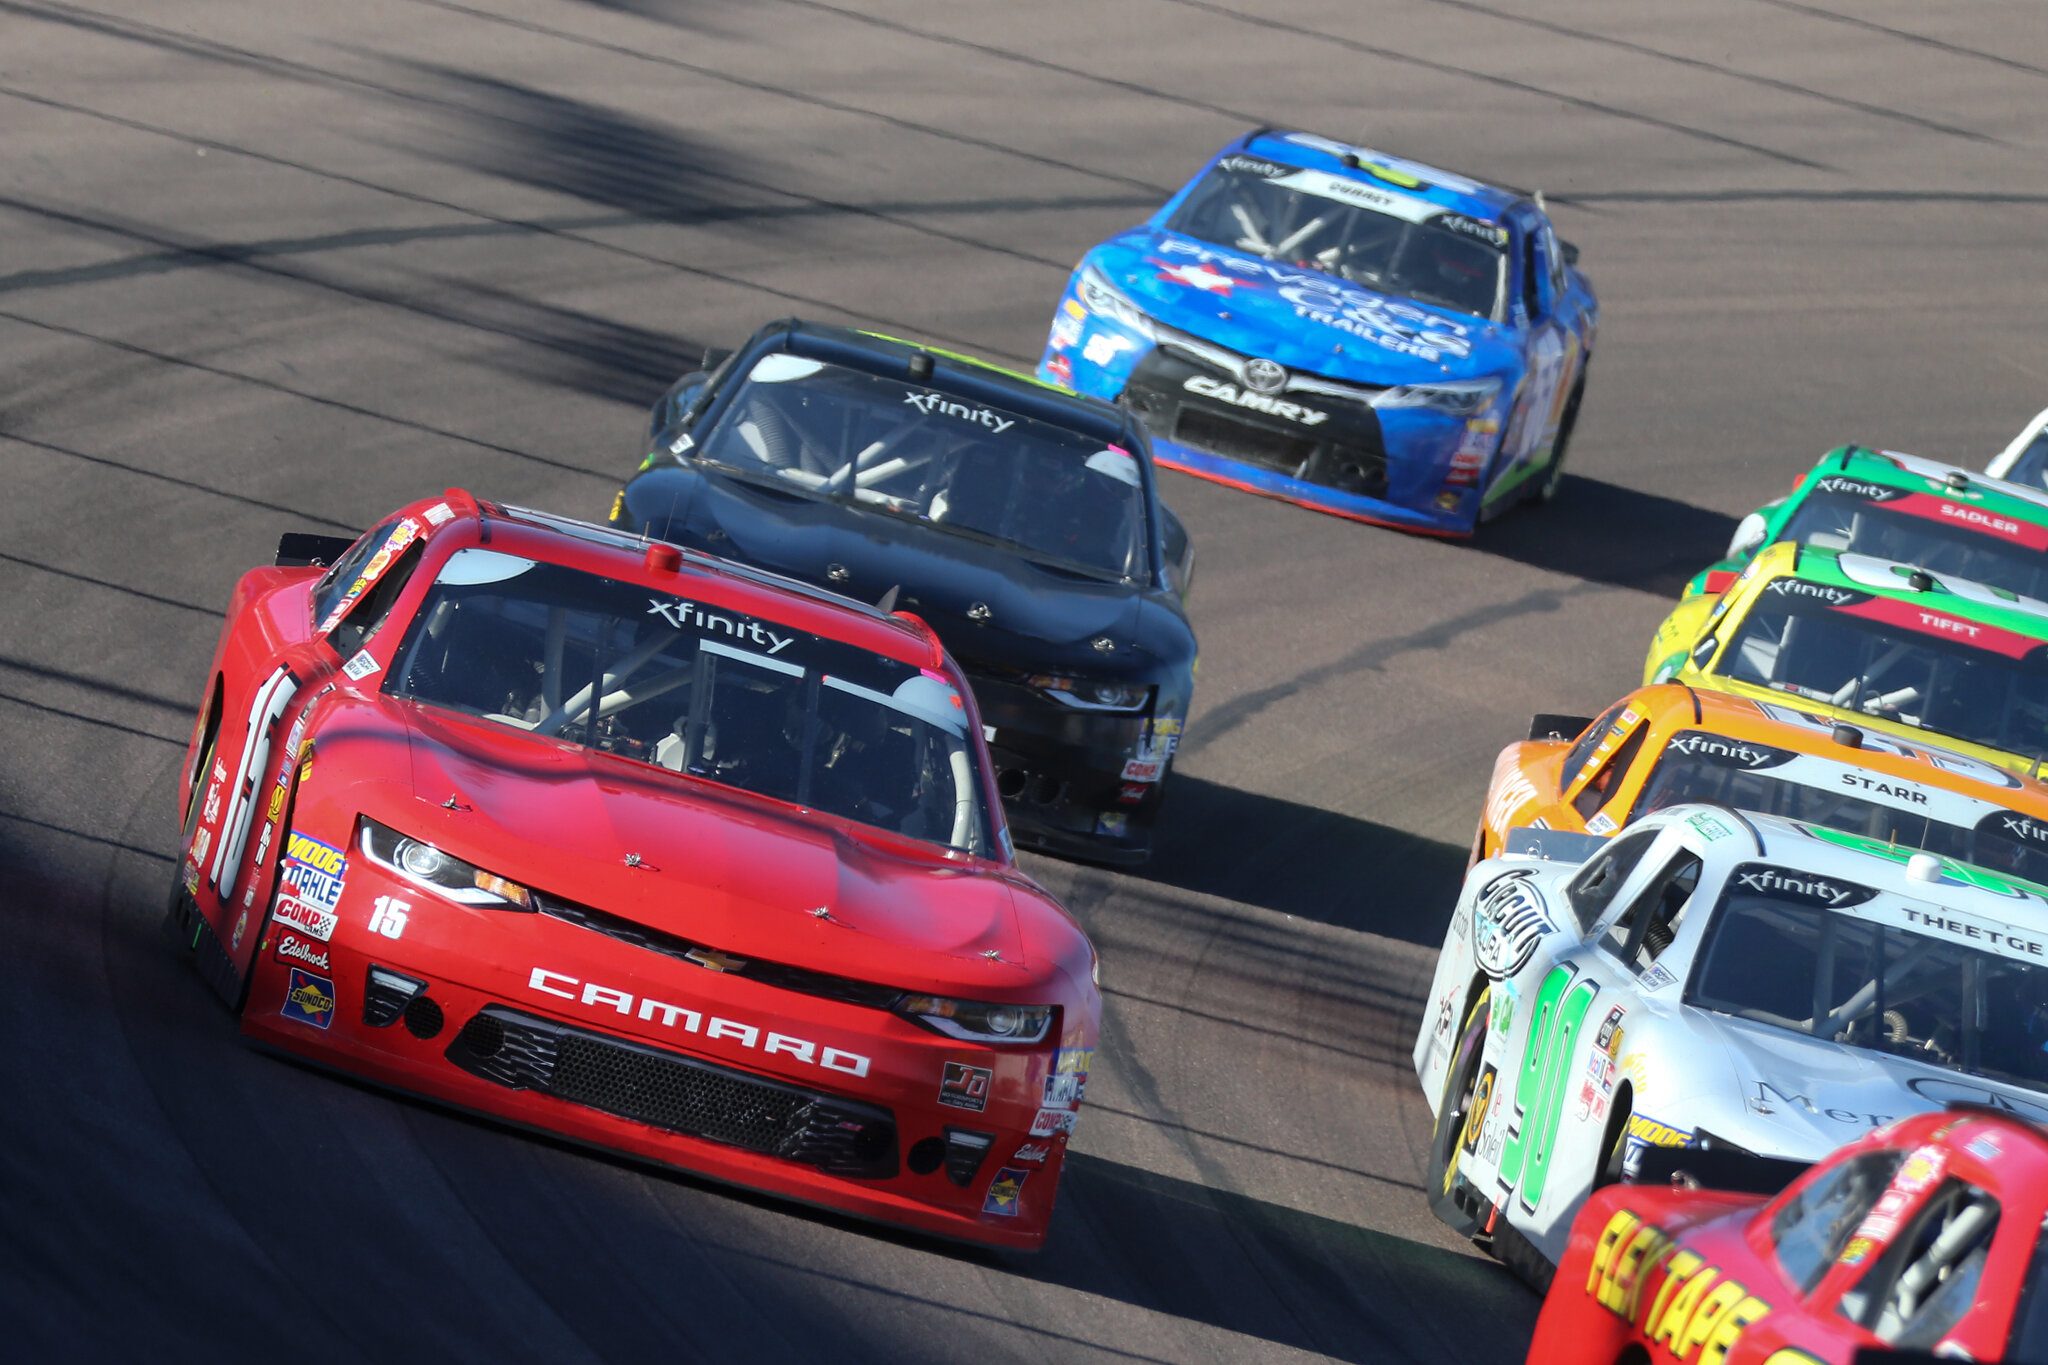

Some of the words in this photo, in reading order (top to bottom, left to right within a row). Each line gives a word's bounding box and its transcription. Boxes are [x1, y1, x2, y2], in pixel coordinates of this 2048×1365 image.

[903, 390, 1016, 434] xfinity
[1182, 375, 1329, 425] CAMRY
[1816, 477, 1897, 502] xfinity
[1940, 503, 2019, 536] SADLER
[1766, 579, 1853, 606] xfinity
[647, 598, 795, 655] xfinity
[1919, 612, 1981, 638] TIFFT
[1665, 735, 1772, 770] xfinity
[1841, 773, 1928, 806] STARR
[287, 832, 345, 877] MOOG
[1736, 869, 1852, 907] xfinity
[275, 898, 321, 927] COMP
[366, 894, 412, 940] 15
[1901, 907, 2044, 957] THEETGE
[278, 935, 330, 970] Edelbrock
[292, 989, 333, 1011] SUNOCO
[528, 966, 872, 1079] CAMARO
